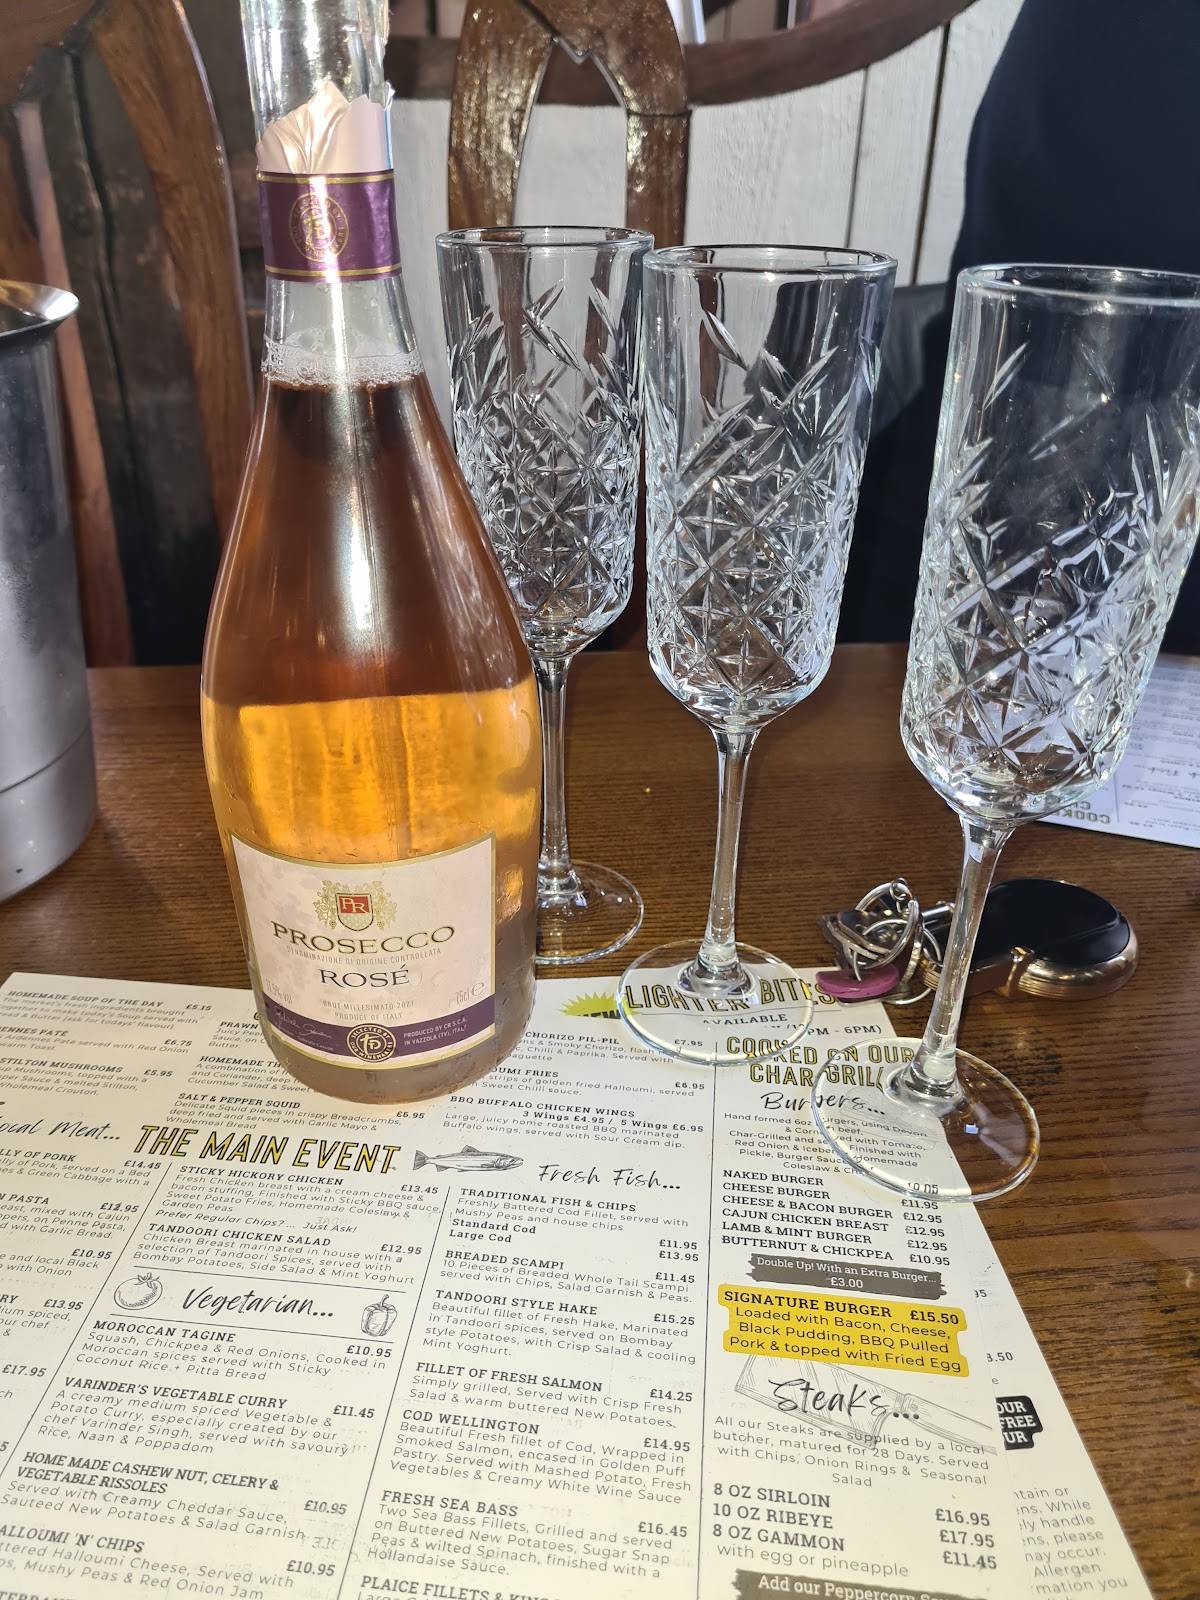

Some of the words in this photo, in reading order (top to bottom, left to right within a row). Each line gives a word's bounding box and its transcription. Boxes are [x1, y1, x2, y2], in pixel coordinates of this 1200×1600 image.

[271, 920, 454, 955] PROSECCO
[319, 964, 409, 987] ROSÉ
[8, 992, 68, 1000] HOMEMADE
[404, 1027, 434, 1038] PRODUCED
[49, 1062, 123, 1072] MUSHROOMS
[750, 1063, 812, 1089] CHAR
[450, 1096, 473, 1104] BBQ
[478, 1098, 532, 1108] BUFFALO
[537, 1104, 590, 1113] CHICKEN
[596, 1108, 634, 1117] WINGS
[534, 1112, 568, 1121] Wings
[632, 1120, 667, 1130] Wings
[673, 1124, 703, 1132] £6.95
[134, 1125, 199, 1157] THE
[199, 1131, 289, 1164] MAIN
[292, 1139, 401, 1174] EVENT
[180, 1166, 225, 1175] STICKY
[228, 1170, 284, 1180] HICKORY
[288, 1175, 343, 1185] CHICKEN
[401, 1185, 438, 1194] £13.45
[539, 1165, 600, 1184] Fresh
[724, 1170, 767, 1180] NAKED
[772, 1174, 823, 1186] BURGER
[461, 1188, 546, 1204] TRADITIONAL
[552, 1197, 581, 1206] FISH
[585, 1200, 594, 1208] &
[598, 1202, 636, 1211] CHIPS
[723, 1195, 774, 1207] CHEESE
[778, 1200, 785, 1208] &
[790, 1202, 834, 1212] BACON
[839, 1206, 892, 1218] BURGER
[904, 1212, 942, 1223] £12.95
[155, 1210, 191, 1220] Prefer
[195, 1213, 242, 1225] Regular
[302, 1223, 329, 1233] Just
[723, 1208, 767, 1220] CAJUN
[772, 1213, 831, 1226] CHICKEN
[836, 1219, 888, 1231] BREAST
[905, 1226, 944, 1237] £12.95
[150, 1224, 218, 1236] TANDOORI
[222, 1230, 283, 1242] CHICKEN
[287, 1236, 330, 1246] SALAD
[381, 1244, 422, 1254] £12.95
[722, 1236, 806, 1251] BUTTERNUT
[811, 1244, 818, 1252] &
[823, 1246, 893, 1260] CHICKPEA
[910, 1254, 950, 1266] £10.95
[133, 1252, 183, 1264] Bombay
[188, 1257, 244, 1269] Potatoes,
[249, 1262, 275, 1272] Side
[280, 1265, 314, 1275] Salad
[317, 1267, 326, 1276] &
[331, 1269, 360, 1279] Mint
[365, 1272, 414, 1284] Yoghurt
[757, 1257, 793, 1268] Double
[796, 1261, 814, 1271] Up!
[816, 1263, 842, 1273] With
[860, 1268, 889, 1278] Extra
[830, 1277, 863, 1289] £3.00
[436, 1290, 506, 1305] TANDOORI
[512, 1298, 554, 1310] STYLE
[559, 1303, 597, 1315] HAKE
[654, 1314, 694, 1325] £15.25
[725, 1291, 818, 1310] SIGNATURE
[824, 1301, 892, 1317] BURGER
[910, 1310, 958, 1324] £15.50
[736, 1307, 790, 1320] Loaded
[796, 1314, 828, 1325] with
[835, 1317, 885, 1332] Bacon,
[890, 1323, 950, 1340] Cheese,
[92, 1320, 177, 1336] MOROCCAN
[182, 1329, 236, 1342] TAGINE
[346, 1345, 392, 1357] £10.95
[76, 1354, 134, 1367] Coconut
[139, 1360, 168, 1370] Rice
[186, 1363, 222, 1377] Pitta
[226, 1368, 266, 1380] Bread
[731, 1337, 765, 1349] Pork
[770, 1341, 779, 1350] &
[785, 1343, 839, 1357] topped
[845, 1350, 879, 1361] with
[886, 1353, 924, 1366] Fried
[930, 1358, 960, 1372] Egg
[416, 1362, 465, 1376] FILLET
[469, 1368, 487, 1378] OF
[491, 1371, 538, 1384] FRESH
[542, 1377, 602, 1392] SALMON
[650, 1389, 692, 1402] £14.25
[23, 1452, 67, 1466] HOME
[68, 1457, 110, 1471] MADE
[112, 1462, 174, 1478] CASHEW
[174, 1469, 207, 1484] NUT,
[212, 1473, 268, 1488] CELERY
[270, 1480, 278, 1490] &
[17, 1467, 98, 1487] VEGETABLE
[98, 1476, 168, 1494] RISSOLES
[304, 1500, 347, 1515] £10.95
[714, 1483, 722, 1495] 8
[729, 1485, 751, 1498] OZ
[758, 1488, 830, 1508] SIRLOIN
[936, 1508, 990, 1526] £16.95
[1046, 1499, 1091, 1512] While
[1040, 1514, 1094, 1528] handle
[1054, 1531, 1103, 1545] please
[368, 1548, 455, 1568] Hollandaise
[460, 1559, 508, 1575] Sauce.
[718, 1544, 754, 1558] with
[760, 1551, 792, 1566] egg
[799, 1555, 814, 1565] or
[822, 1556, 908, 1577] pineapple
[1035, 1561, 1101, 1577] Allergen
